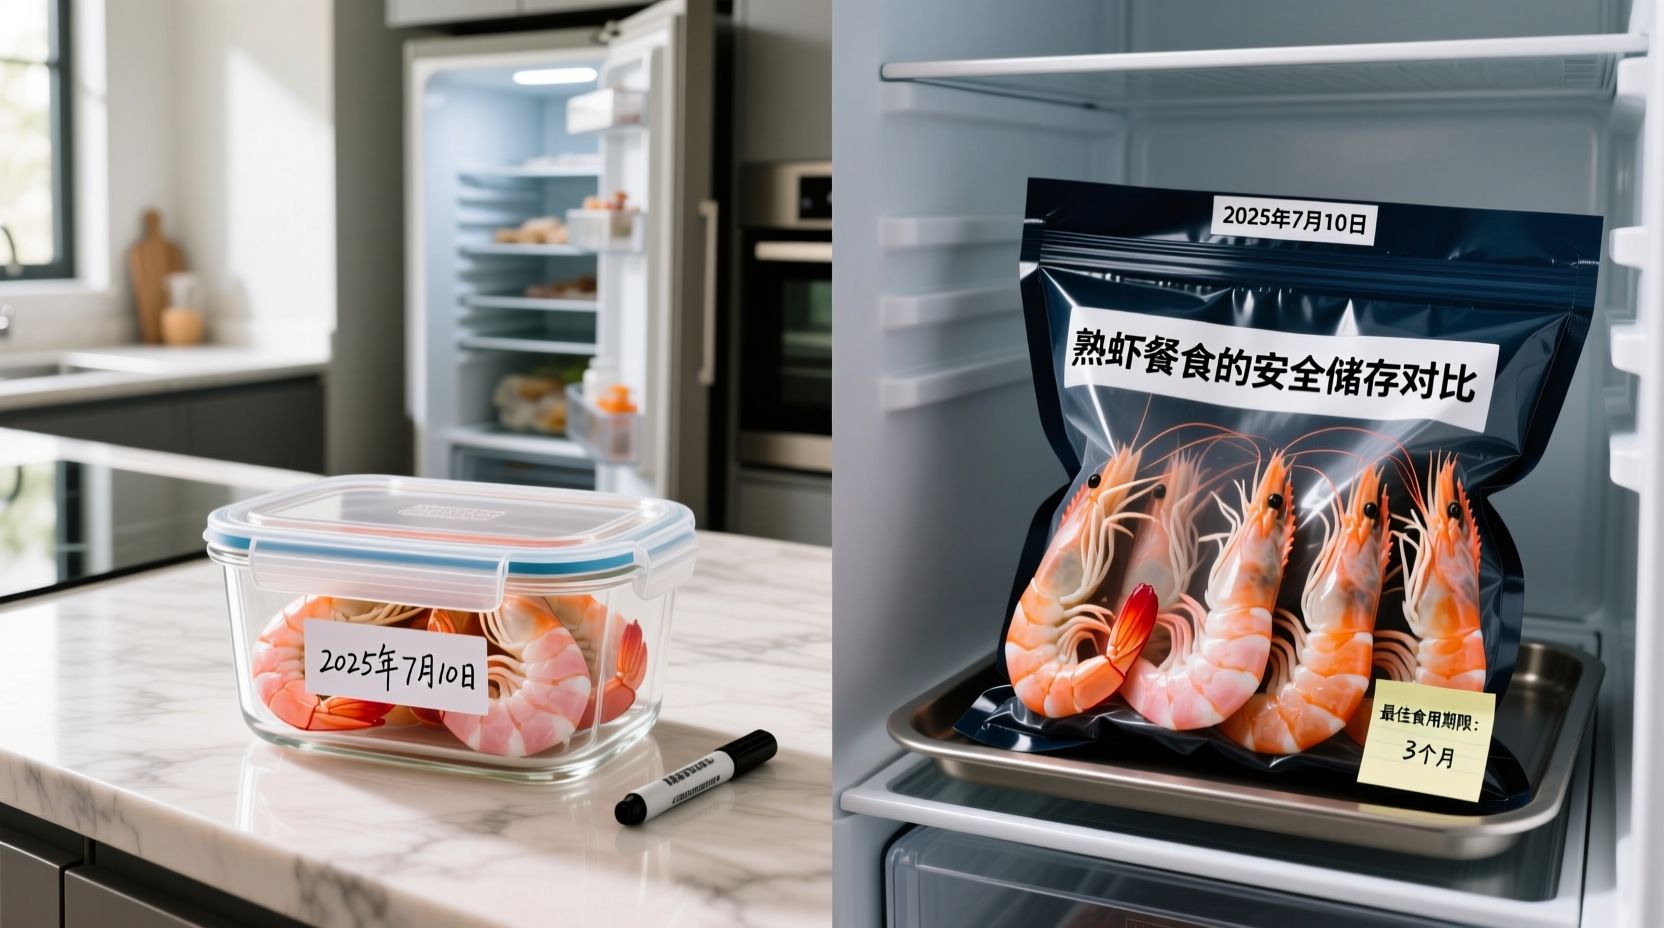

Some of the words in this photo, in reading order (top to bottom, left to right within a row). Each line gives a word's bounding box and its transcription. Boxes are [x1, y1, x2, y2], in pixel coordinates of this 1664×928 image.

[1222, 205, 1367, 236] 2025年7月10日
[1071, 327, 1478, 404] 熟虾餐食的安全储存对比
[319, 643, 475, 692] 2025年7月10日
[1379, 703, 1479, 732] 最佳食用期限：
[1402, 740, 1454, 769] 3个月
